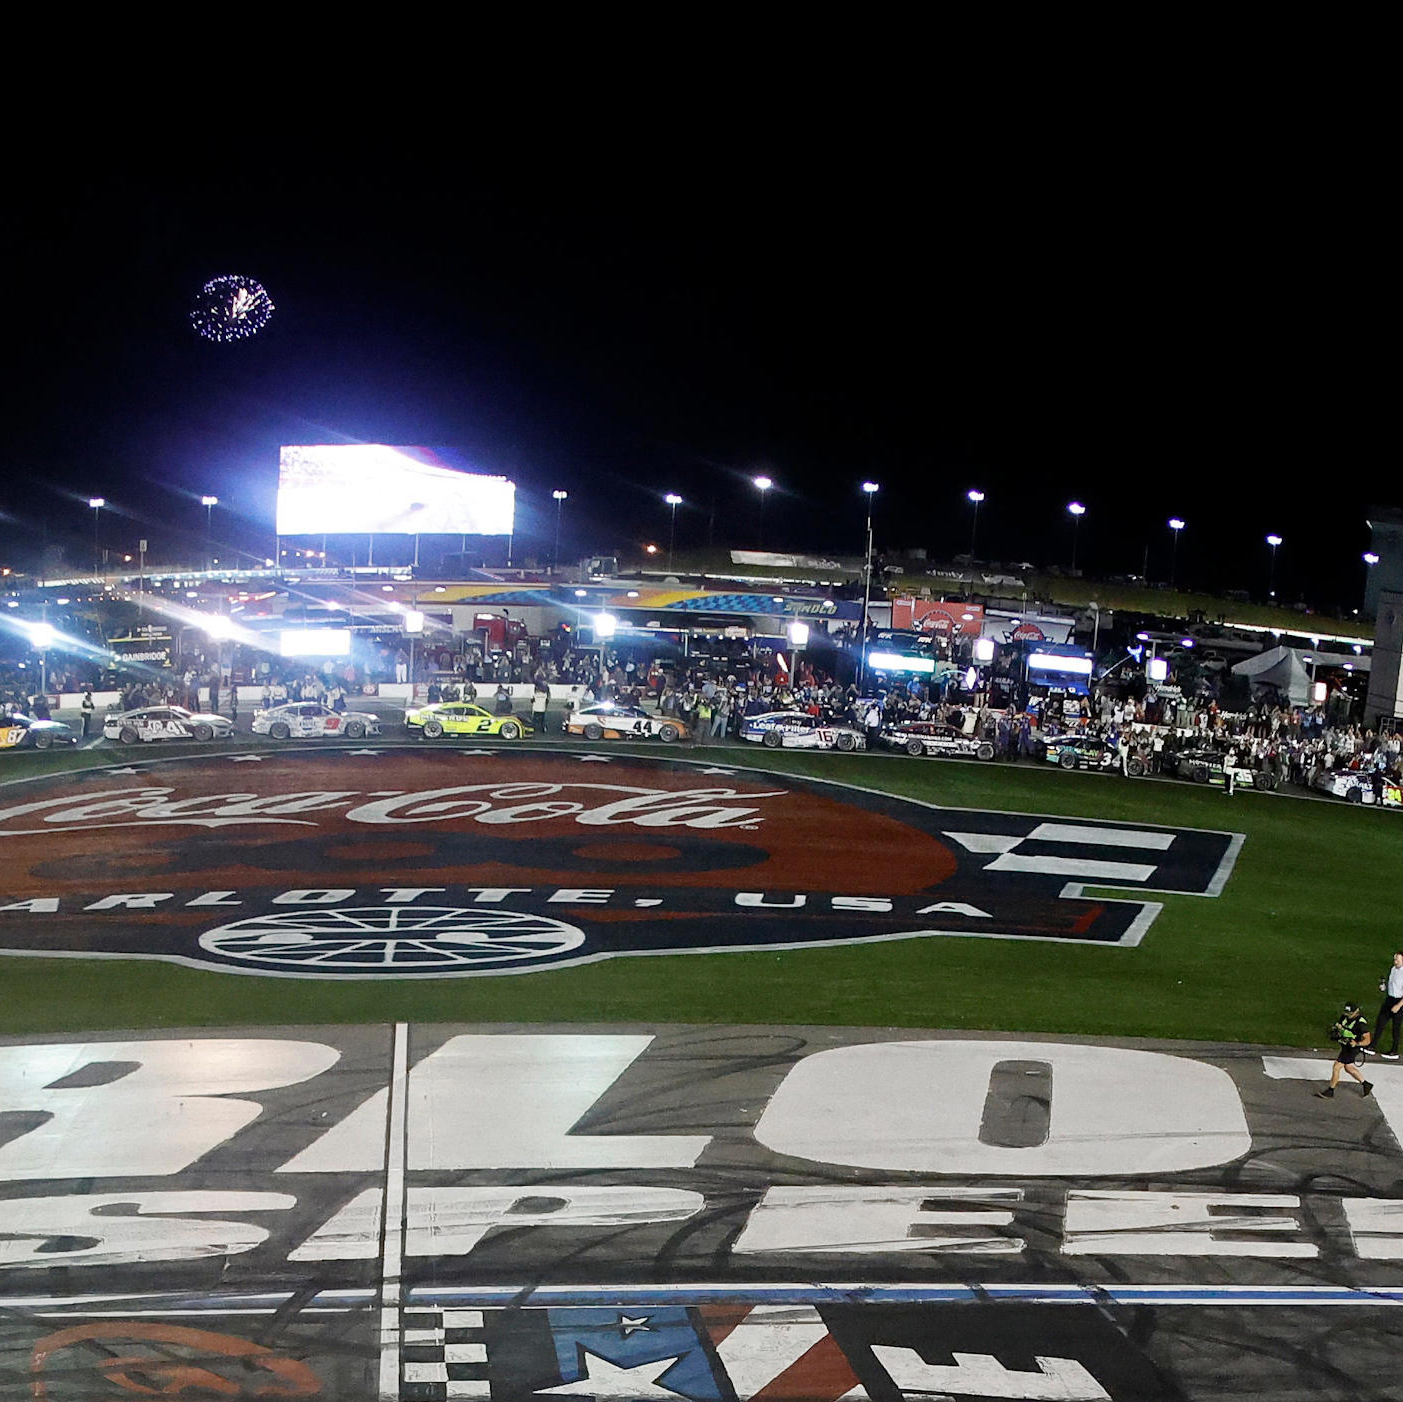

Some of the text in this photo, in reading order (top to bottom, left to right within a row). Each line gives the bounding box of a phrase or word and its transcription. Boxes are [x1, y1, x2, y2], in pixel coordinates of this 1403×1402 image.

[122, 650, 167, 663] GAINBRIDGE
[325, 718, 341, 730] 9
[476, 719, 493, 732] 2
[633, 720, 652, 736] 44
[6, 728, 28, 744] 87
[816, 728, 834, 744] 16
[1100, 751, 1121, 768] 34
[735, 893, 993, 918] USA
